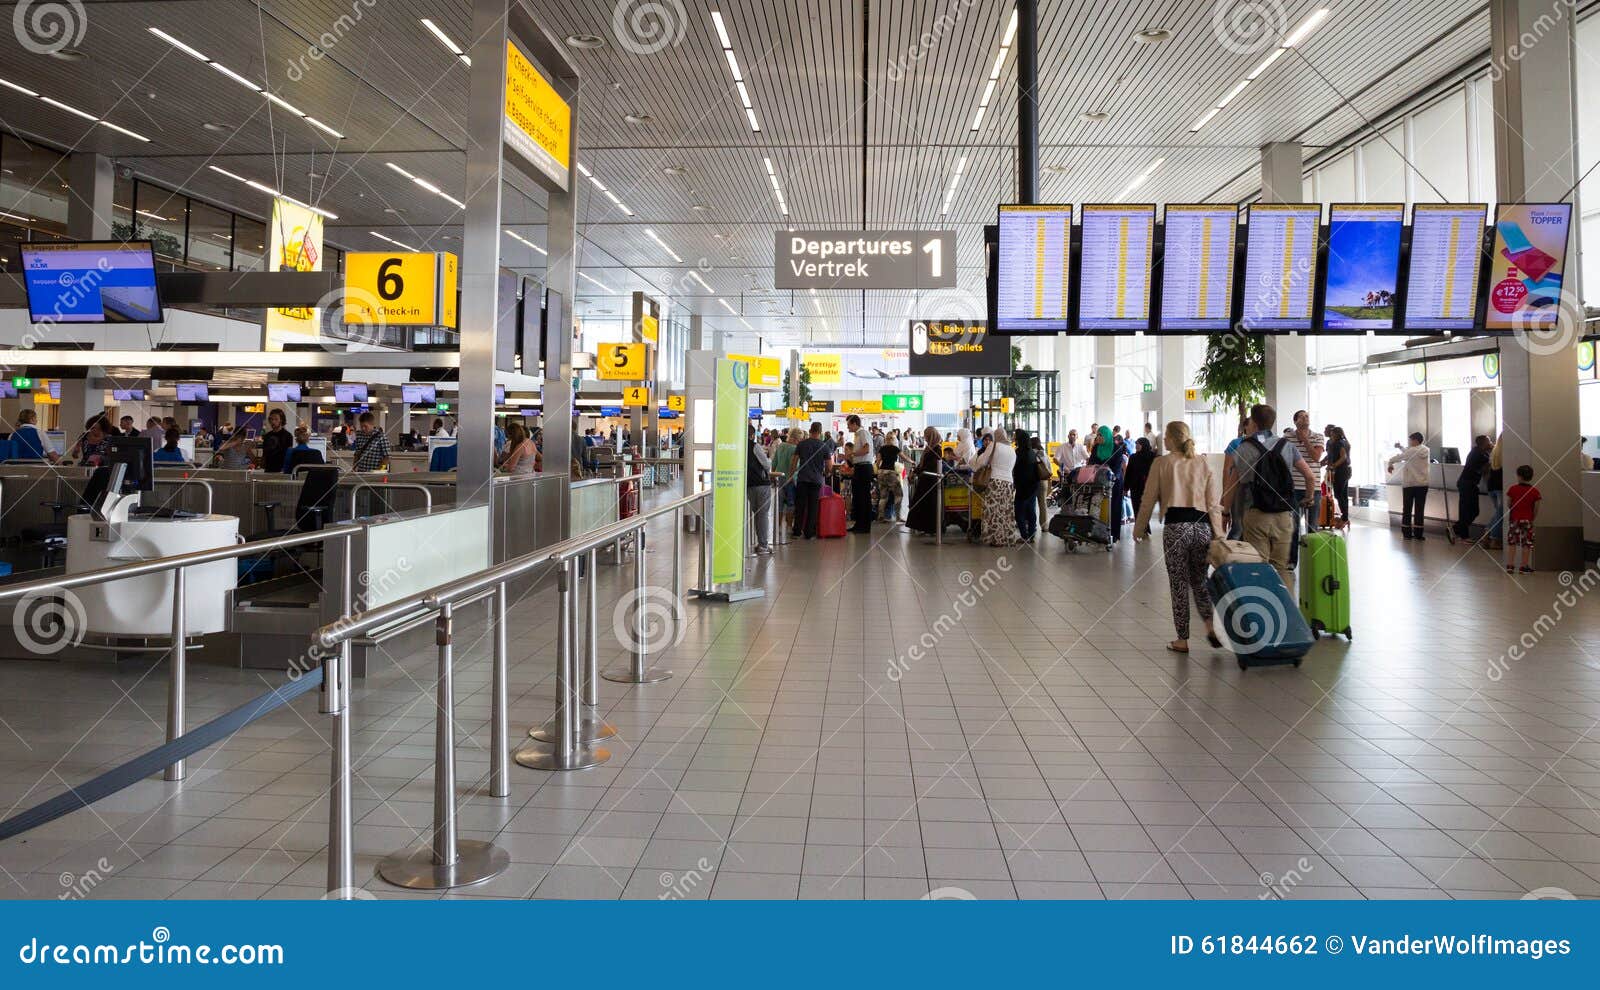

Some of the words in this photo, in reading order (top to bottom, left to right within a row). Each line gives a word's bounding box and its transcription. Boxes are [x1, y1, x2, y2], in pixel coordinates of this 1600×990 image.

[1530, 216, 1562, 224] TOPPER
[791, 237, 912, 258] Departures
[922, 238, 942, 277] 1
[790, 258, 869, 277] Vertrek
[377, 258, 404, 300] 6
[378, 306, 420, 316] Check-in
[943, 323, 965, 334] Baby
[968, 325, 986, 334] care
[954, 343, 983, 352] Toilets
[614, 346, 628, 368] 5
[632, 388, 640, 400] 4
[1188, 390, 1194, 398] H
[676, 396, 682, 406] 3
